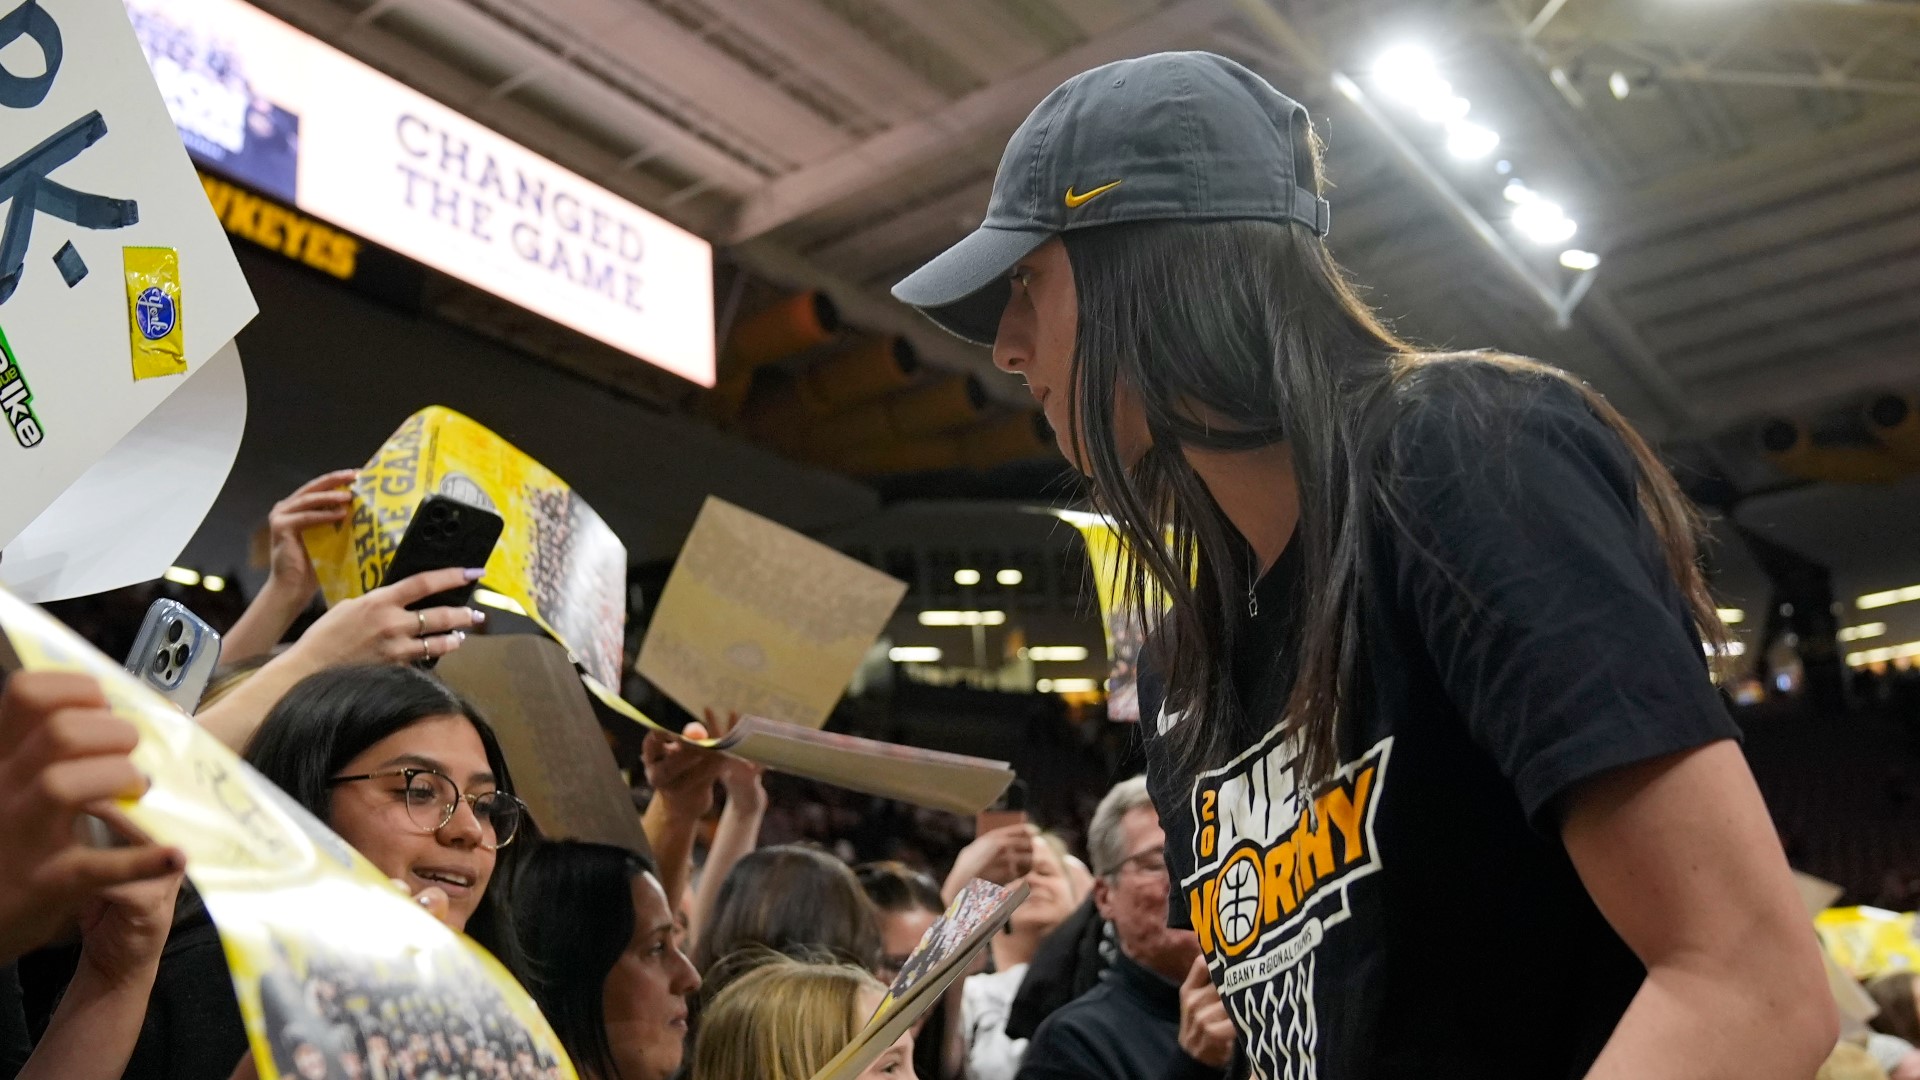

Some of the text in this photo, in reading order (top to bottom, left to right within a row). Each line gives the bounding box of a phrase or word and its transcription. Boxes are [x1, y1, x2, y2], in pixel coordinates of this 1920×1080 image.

[396, 113, 645, 264] CHANGED
[397, 163, 644, 314] THE GAME
[138, 288, 168, 335] York
[1217, 729, 1307, 862] NE
[1226, 964, 1256, 989] ALBANY
